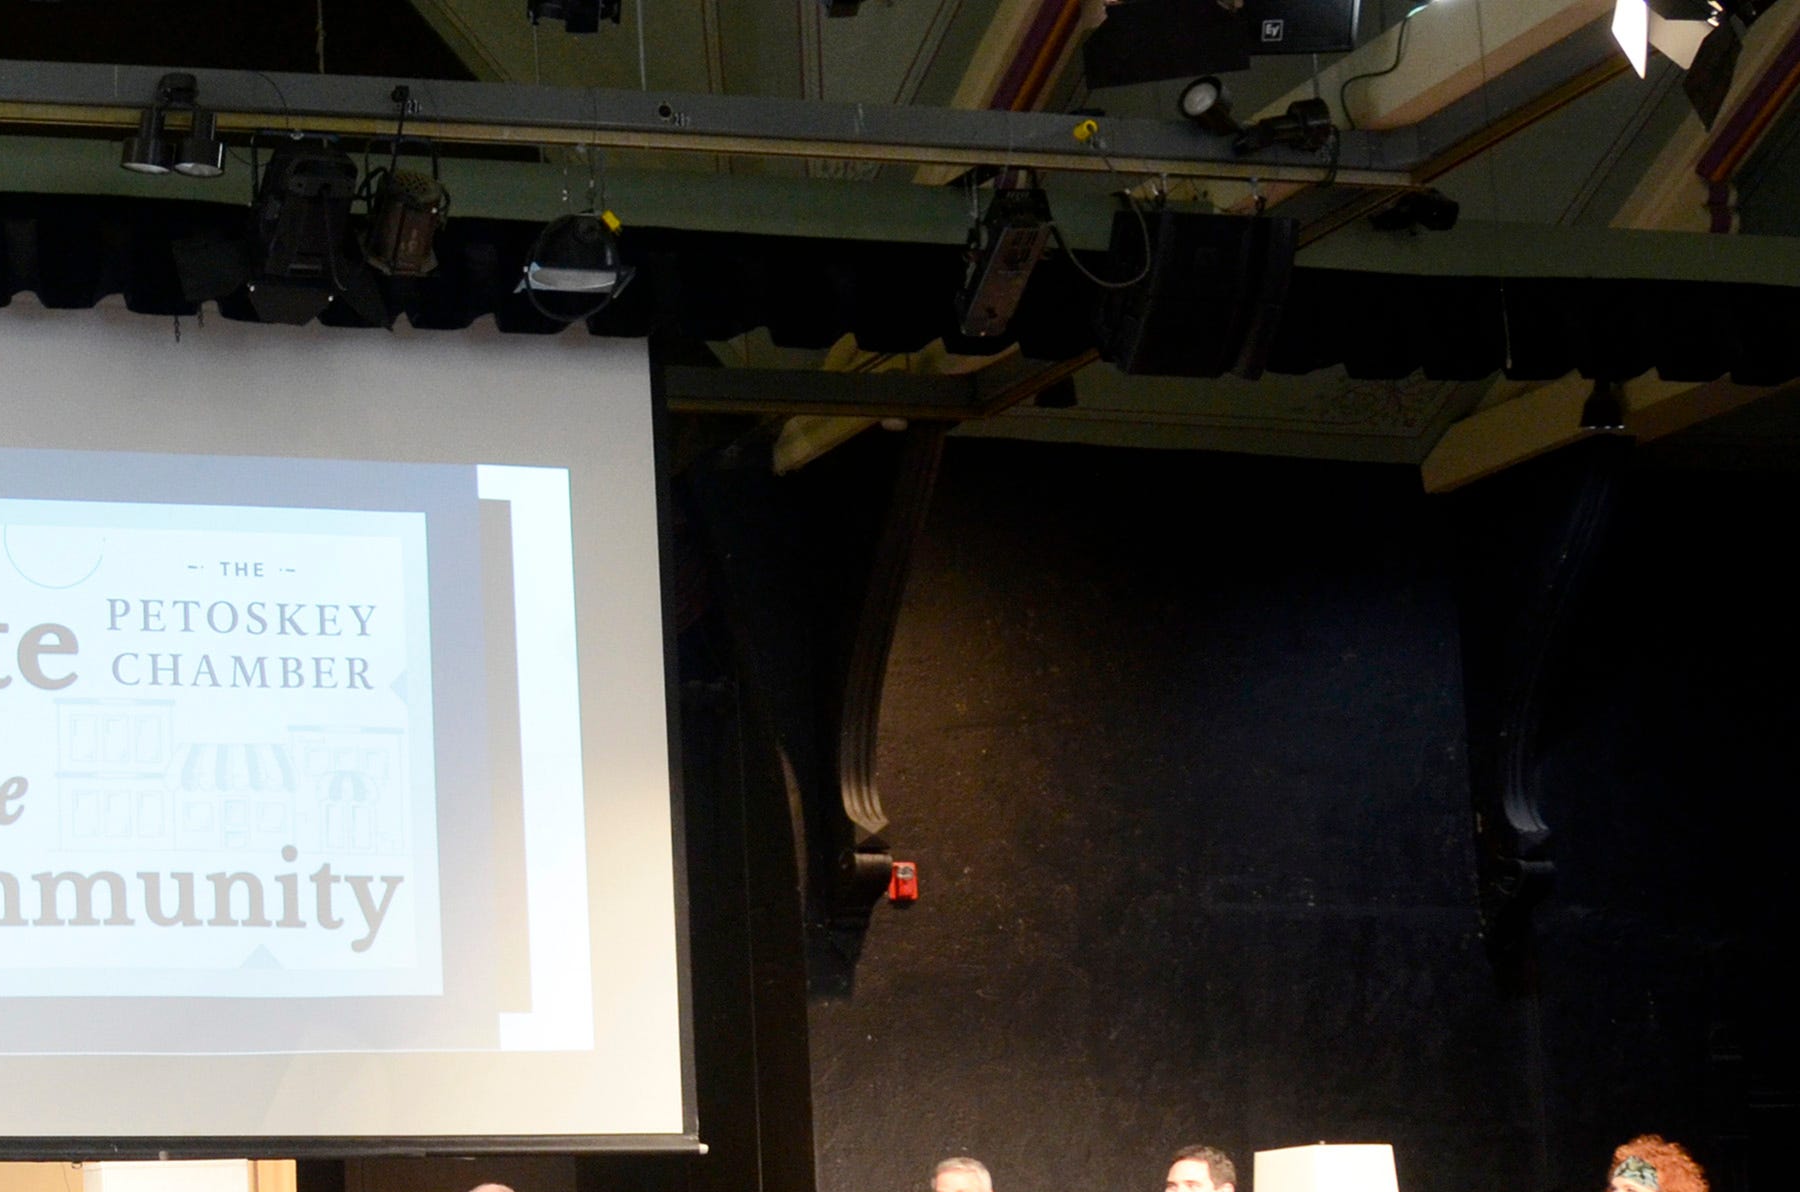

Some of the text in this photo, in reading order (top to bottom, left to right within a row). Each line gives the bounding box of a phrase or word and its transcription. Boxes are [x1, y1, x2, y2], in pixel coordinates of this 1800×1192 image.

[219, 560, 265, 577] THE
[105, 598, 377, 638] PETOSKEY
[111, 653, 375, 690] CHAMBER
